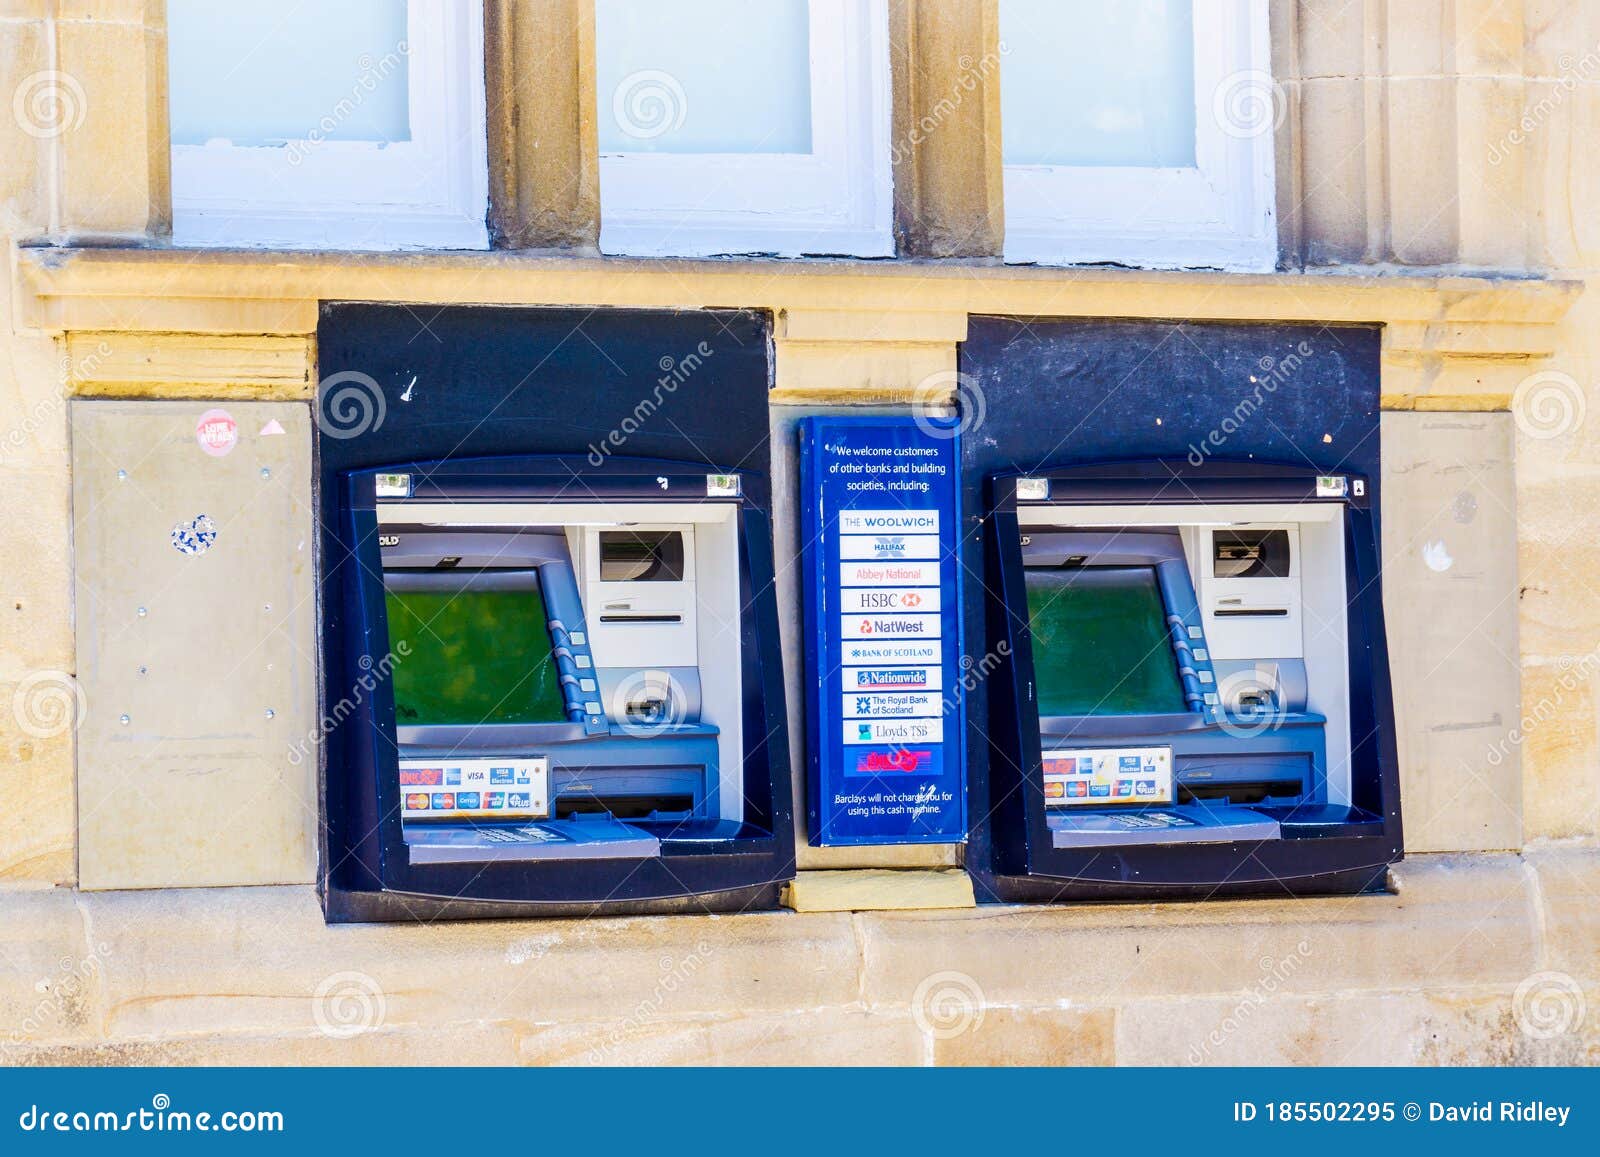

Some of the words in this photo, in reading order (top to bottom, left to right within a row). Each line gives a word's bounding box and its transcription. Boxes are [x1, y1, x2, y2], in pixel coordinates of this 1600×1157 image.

[836, 446, 852, 457] We
[853, 446, 892, 457] welcome
[893, 446, 939, 457] customers
[829, 463, 840, 474] of
[840, 463, 865, 474] other
[865, 463, 892, 474] banks
[892, 463, 910, 474] and
[911, 463, 946, 476] building
[846, 481, 887, 492] societies,
[888, 481, 930, 493] including:
[845, 517, 861, 527] THE
[864, 516, 934, 527] WOOLWICH
[874, 543, 906, 551] HALIFAX
[856, 568, 883, 582] Abbey
[886, 567, 921, 579] National
[860, 593, 898, 608] HSBC
[874, 620, 924, 633] NatWest
[862, 649, 881, 657] BANK
[894, 648, 933, 656] SCOTLAND
[869, 671, 926, 683] Nationwide
[872, 696, 887, 705] The
[887, 696, 908, 706] Royal
[909, 695, 928, 704] Bank
[872, 706, 880, 714] of
[881, 706, 913, 714] Scotland
[876, 725, 908, 740] Lloyds
[910, 724, 928, 736] TSB
[467, 771, 485, 780] VISA
[835, 794, 867, 804] Barclays
[868, 793, 881, 802] will
[883, 793, 896, 802] not
[941, 791, 953, 801] for
[847, 806, 869, 817] using
[870, 805, 885, 815] this
[886, 805, 905, 815] cash
